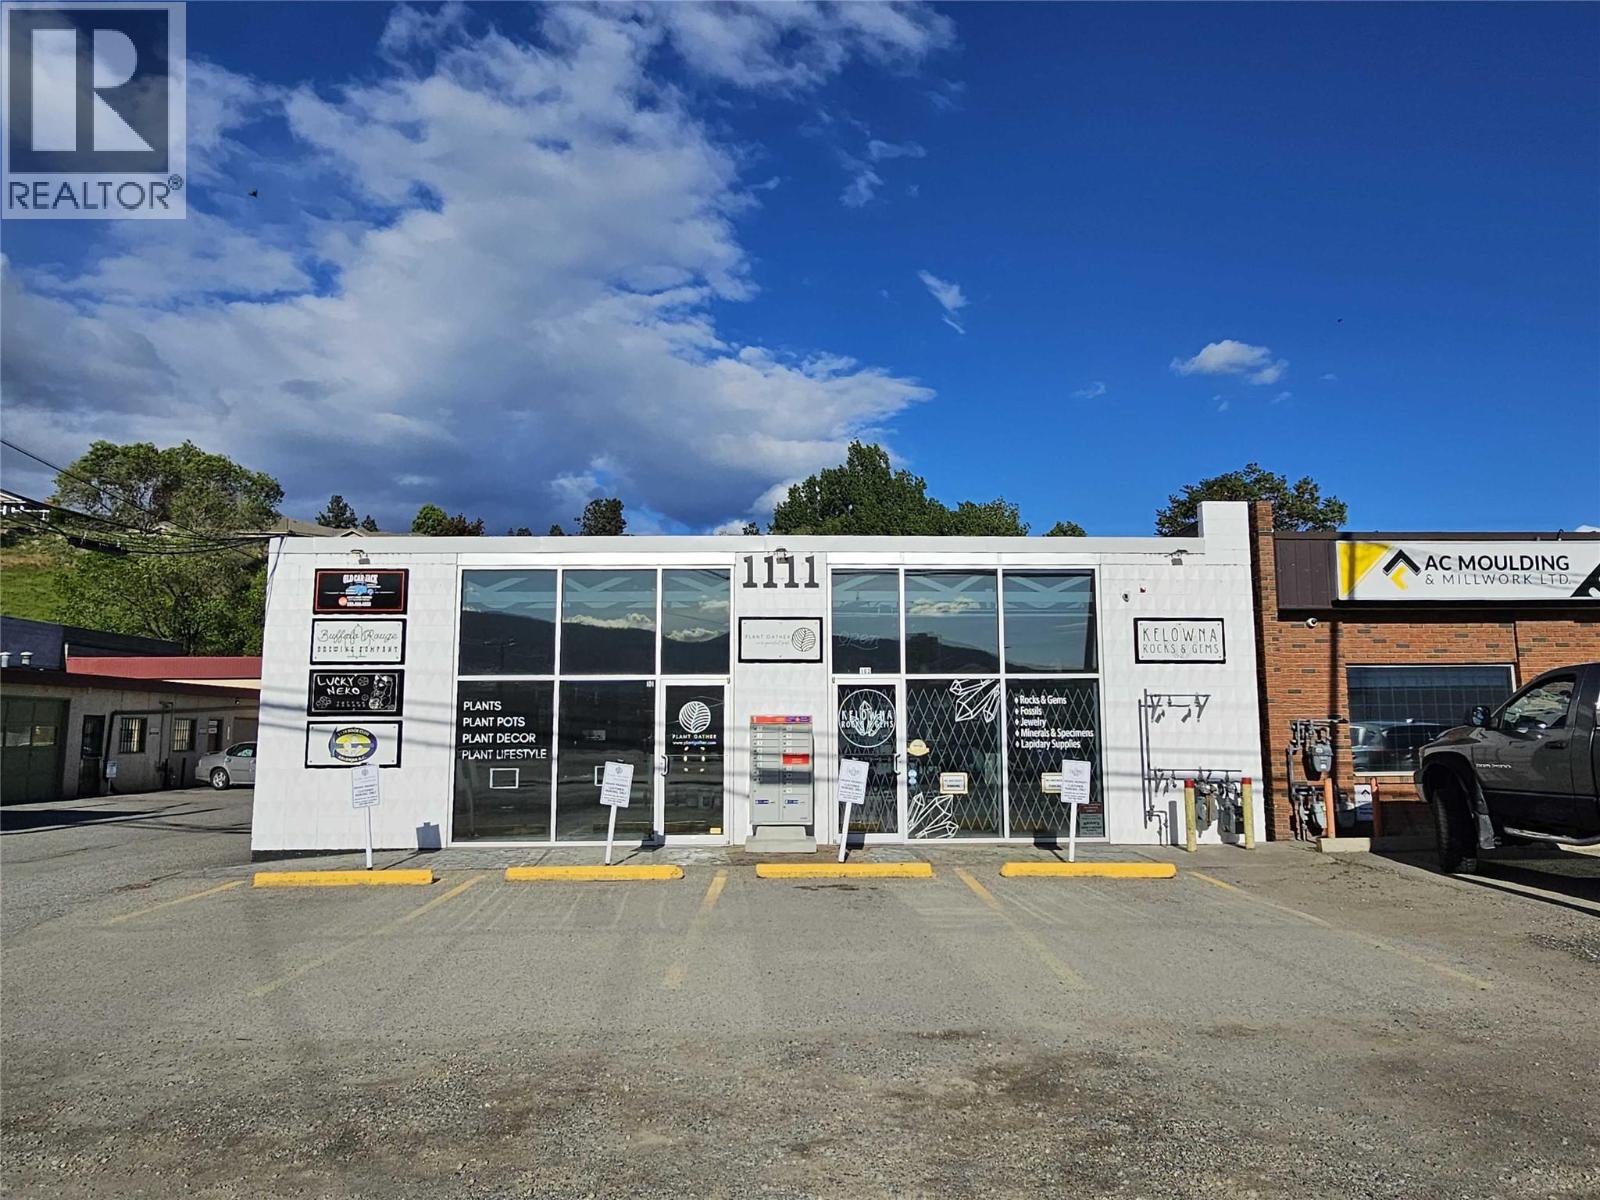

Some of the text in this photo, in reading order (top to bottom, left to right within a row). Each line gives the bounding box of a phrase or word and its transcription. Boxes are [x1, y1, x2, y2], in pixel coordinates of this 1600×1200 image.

[1425, 555, 1569, 571] AC MOULDING
[742, 555, 819, 588] 1111
[1425, 574, 1572, 585] & MILLWORK LTD.
[1142, 627, 1218, 642] KELOWNA
[1142, 644, 1220, 654] ROCKS & GEMS
[317, 676, 354, 687] LUCKY
[326, 686, 360, 696] NEKO
[1020, 695, 1067, 705] Rocks & Gems
[463, 701, 502, 711] PLANTS
[1020, 706, 1042, 715] Fossils
[463, 717, 526, 727] PLANT POTS
[1020, 717, 1047, 728] Jewelry
[462, 733, 536, 744] PLANT DECOR
[1020, 728, 1094, 739] Minerals & Specimens
[1021, 739, 1081, 750] Lapidary Supplies
[462, 749, 547, 760] PLANT LIFESTYLE
